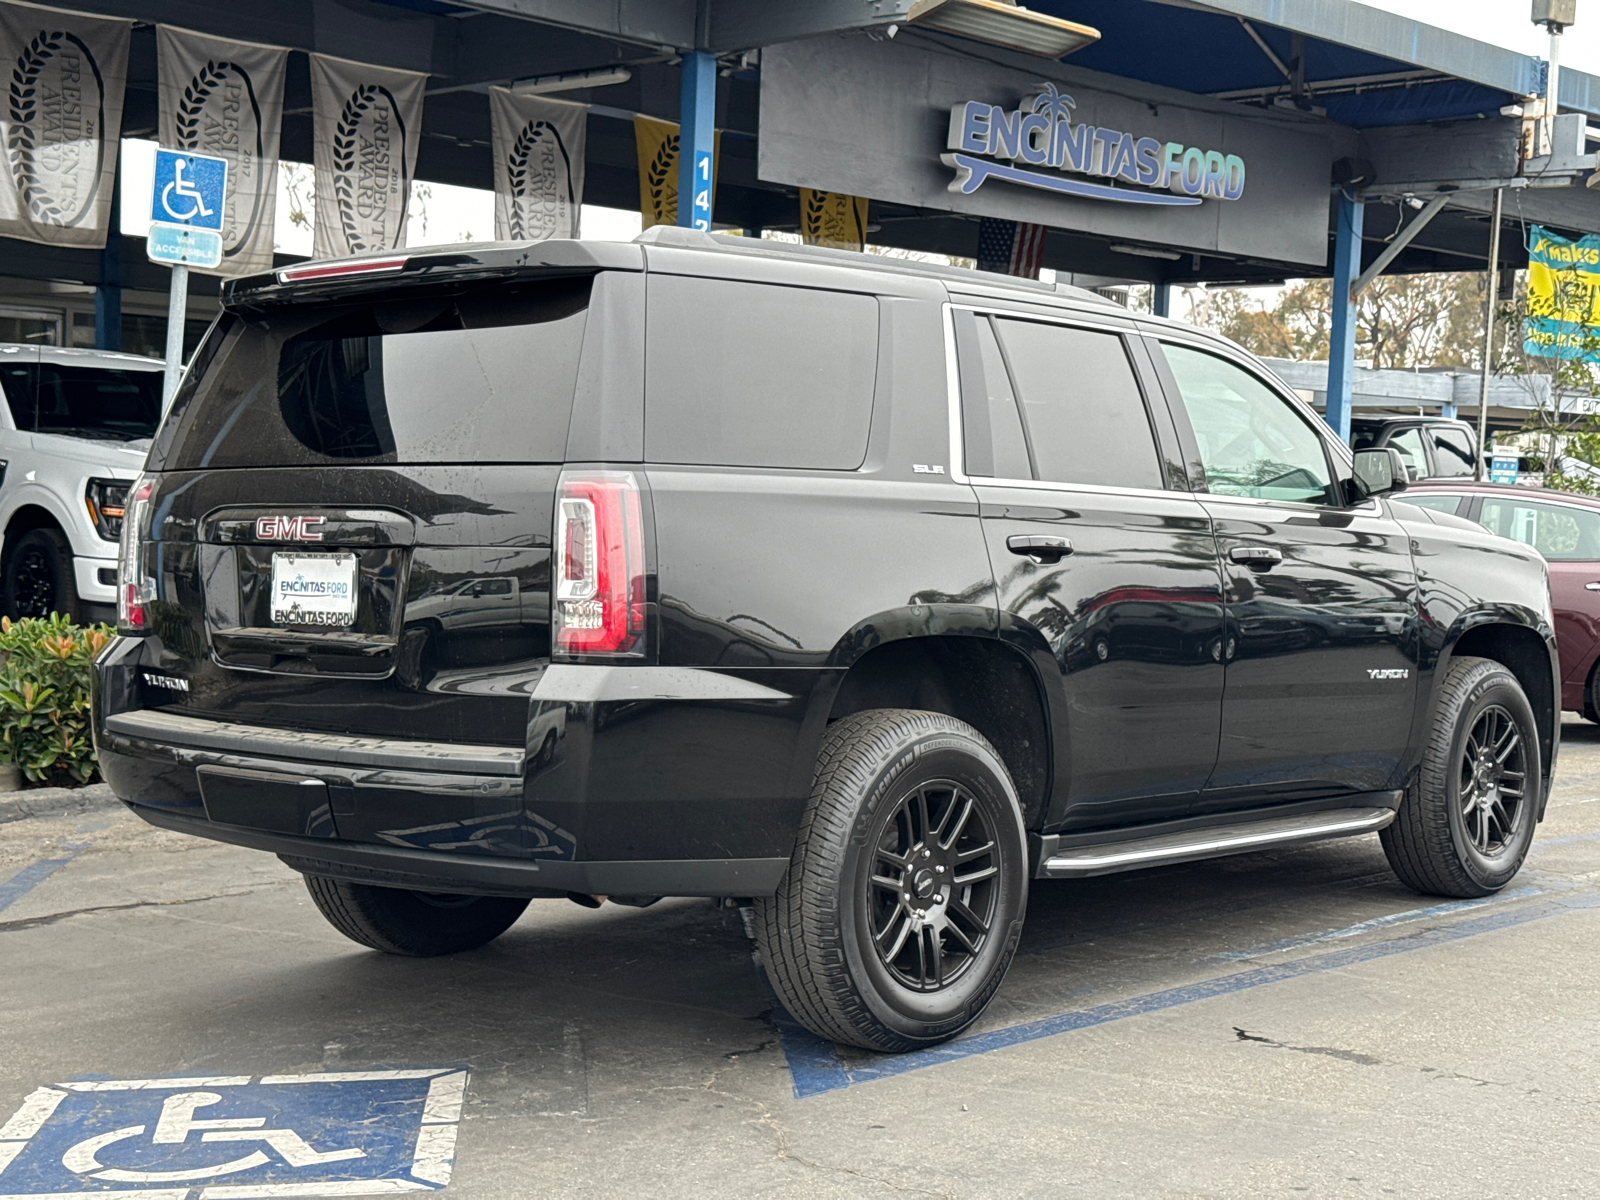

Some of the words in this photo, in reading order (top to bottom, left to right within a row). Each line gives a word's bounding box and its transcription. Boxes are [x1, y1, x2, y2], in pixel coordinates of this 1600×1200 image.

[41, 84, 62, 172] AWARD
[60, 53, 82, 213] PRESIDENT'S
[961, 92, 1161, 186] ENCINITAS
[1163, 142, 1246, 201] FORD
[242, 149, 252, 177] 2017
[357, 135, 374, 219] AWARD
[390, 167, 399, 194] 2018
[528, 165, 543, 239] AWARD
[155, 244, 214, 258] ACCESSIBLE
[176, 235, 195, 245] VAN
[256, 515, 326, 541] GMC
[281, 578, 325, 593] ENCINITAS
[327, 582, 347, 594] FORD
[274, 607, 324, 624] ENCINITAS
[326, 612, 350, 626] FORD
[143, 673, 189, 691] YUKON
[1366, 669, 1409, 679] YUKON
[867, 751, 914, 815] MICHELIN
